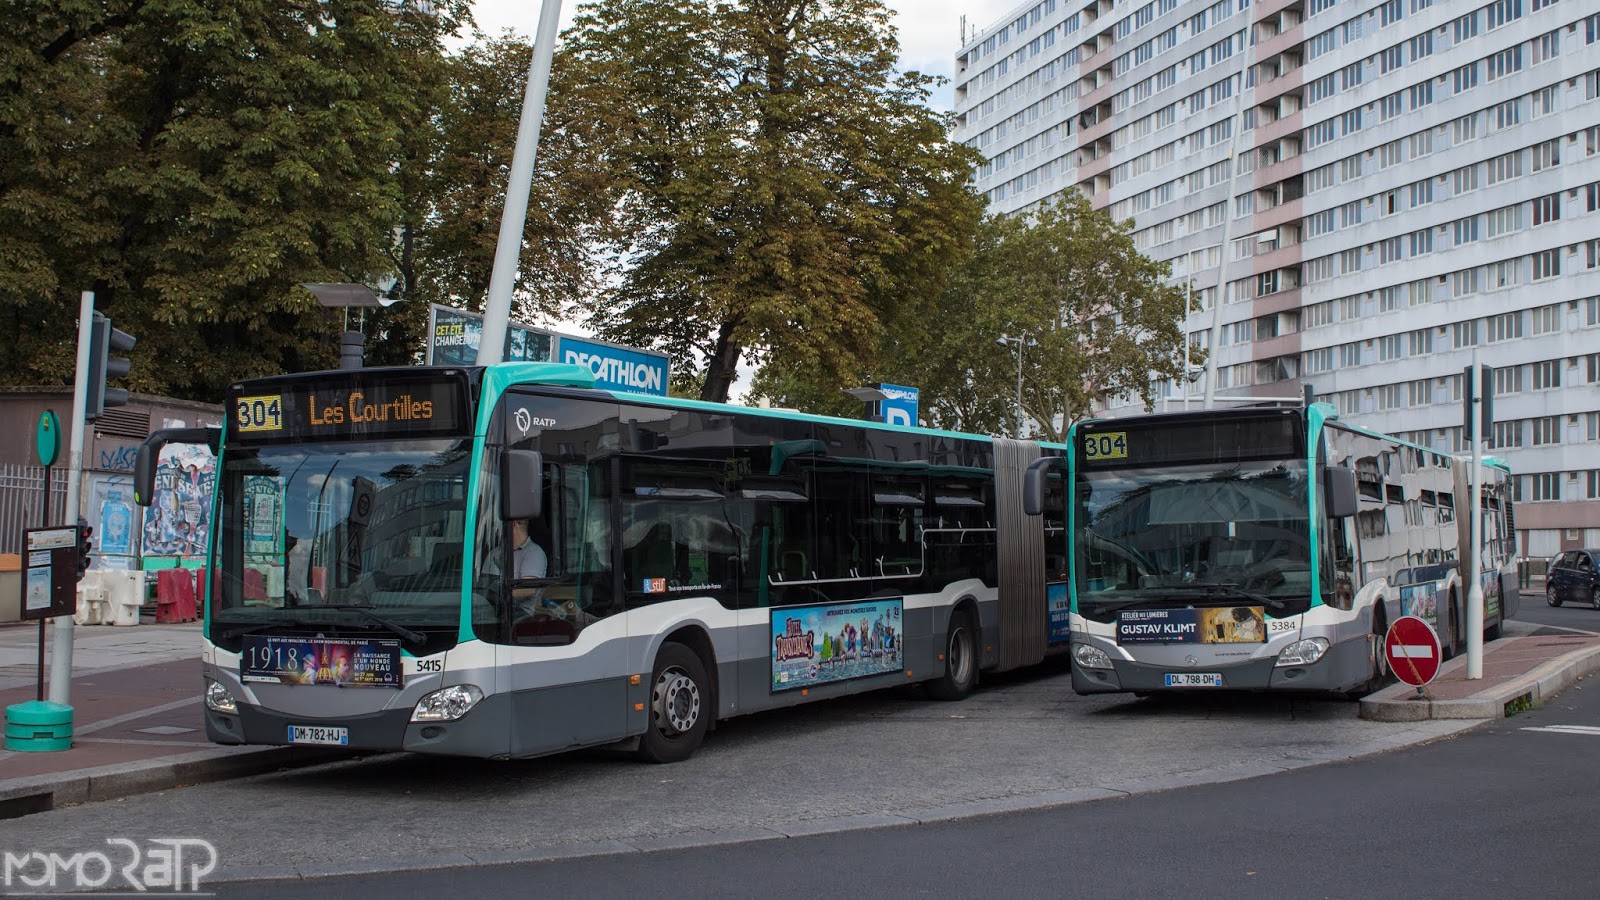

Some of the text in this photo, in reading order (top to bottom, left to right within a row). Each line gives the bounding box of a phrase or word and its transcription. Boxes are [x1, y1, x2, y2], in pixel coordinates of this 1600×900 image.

[436, 325, 449, 336] CET
[565, 349, 661, 391] DECATHLON
[237, 399, 281, 427] 304
[309, 392, 433, 425] Les Courtilles
[533, 417, 556, 427] RATP
[1084, 434, 1126, 457] 304
[1121, 623, 1196, 634] GUSTAV KLIMT
[1271, 621, 1296, 631] 5384
[249, 646, 298, 670] 1918
[354, 663, 391, 671] NOUVEAU
[416, 659, 441, 672] 5415
